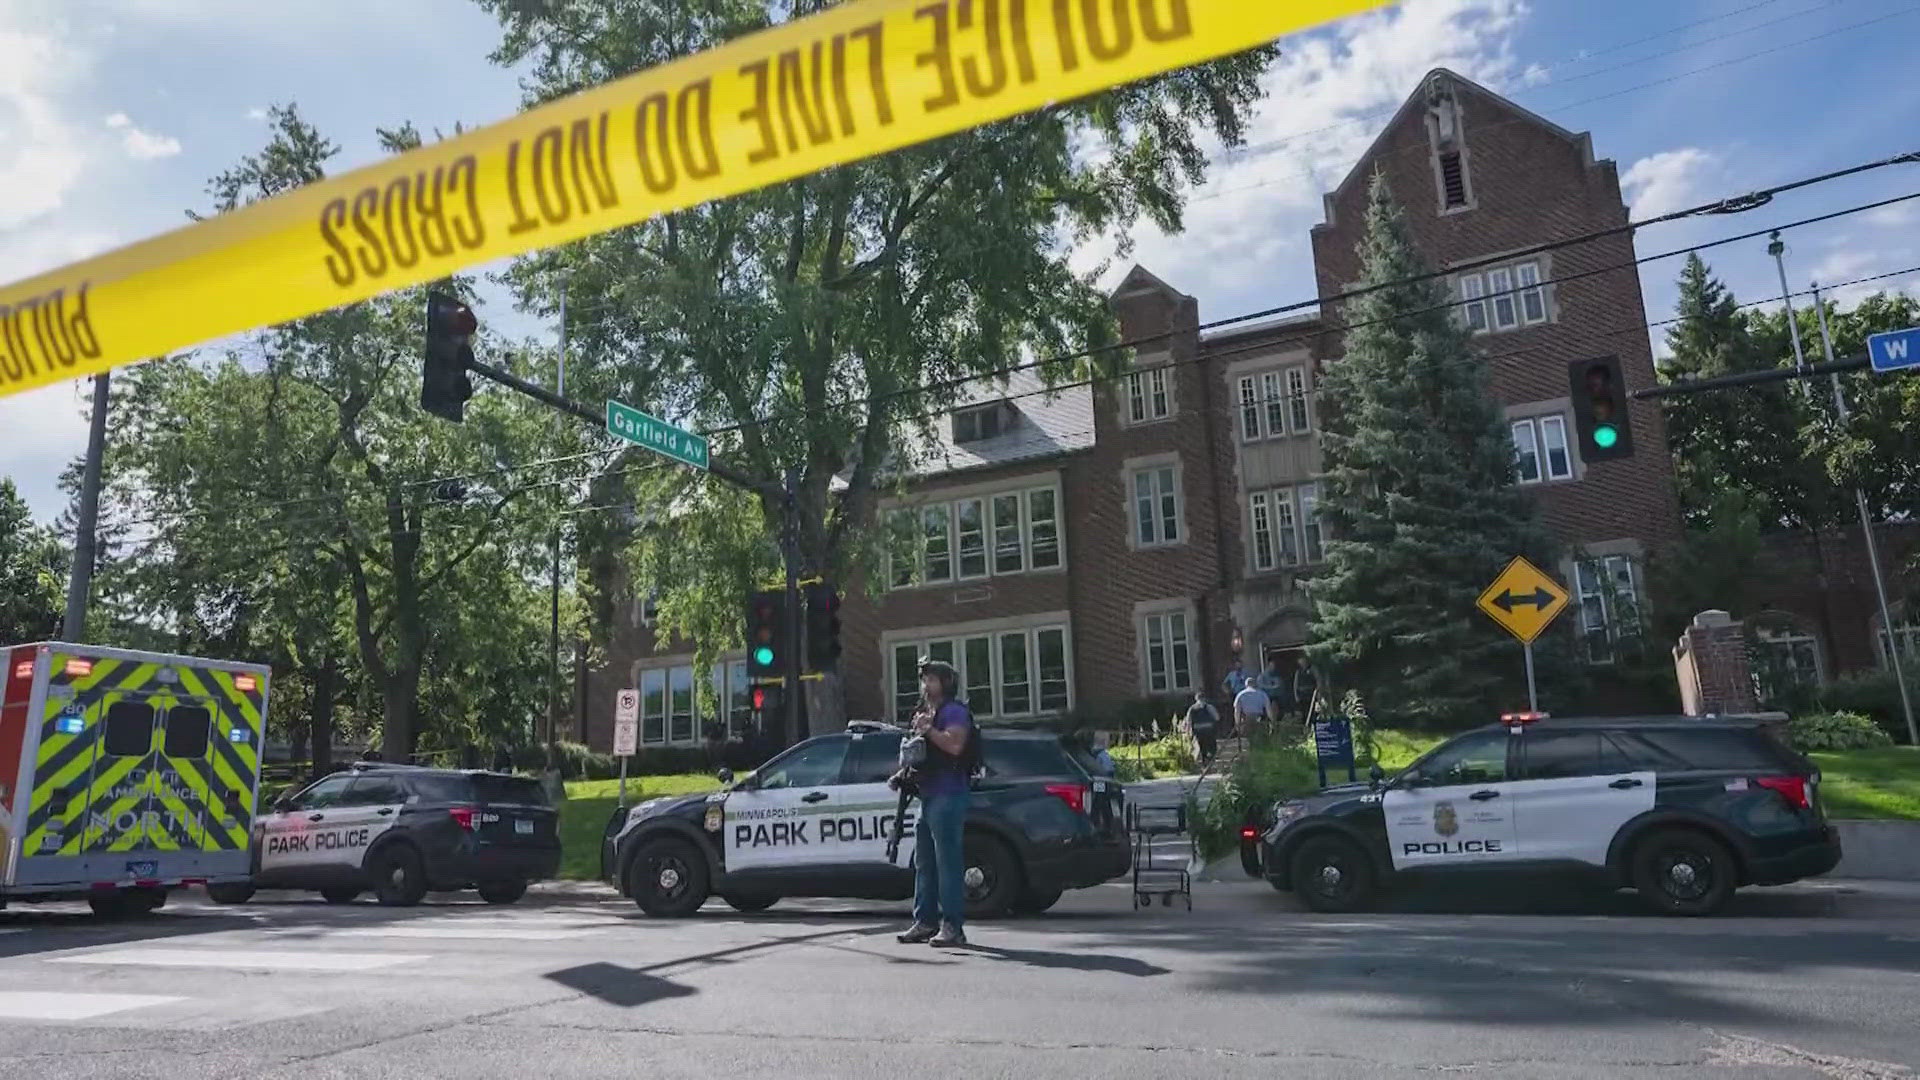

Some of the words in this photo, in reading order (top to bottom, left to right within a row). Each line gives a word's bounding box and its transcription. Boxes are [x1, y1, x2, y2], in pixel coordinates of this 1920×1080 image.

[738, 21, 894, 165] LINE
[636, 77, 720, 194] DO
[508, 111, 619, 235] NOT
[320, 154, 486, 287] CROSS
[1883, 339, 1908, 360] W
[615, 412, 677, 450] Garfield
[684, 440, 702, 459] Av
[90, 810, 203, 833] NORTH
[269, 834, 309, 855] PARK
[315, 829, 369, 850] POLICE
[736, 820, 808, 848] PARK
[820, 813, 915, 844] POLICE
[1404, 840, 1502, 855] POLICE
